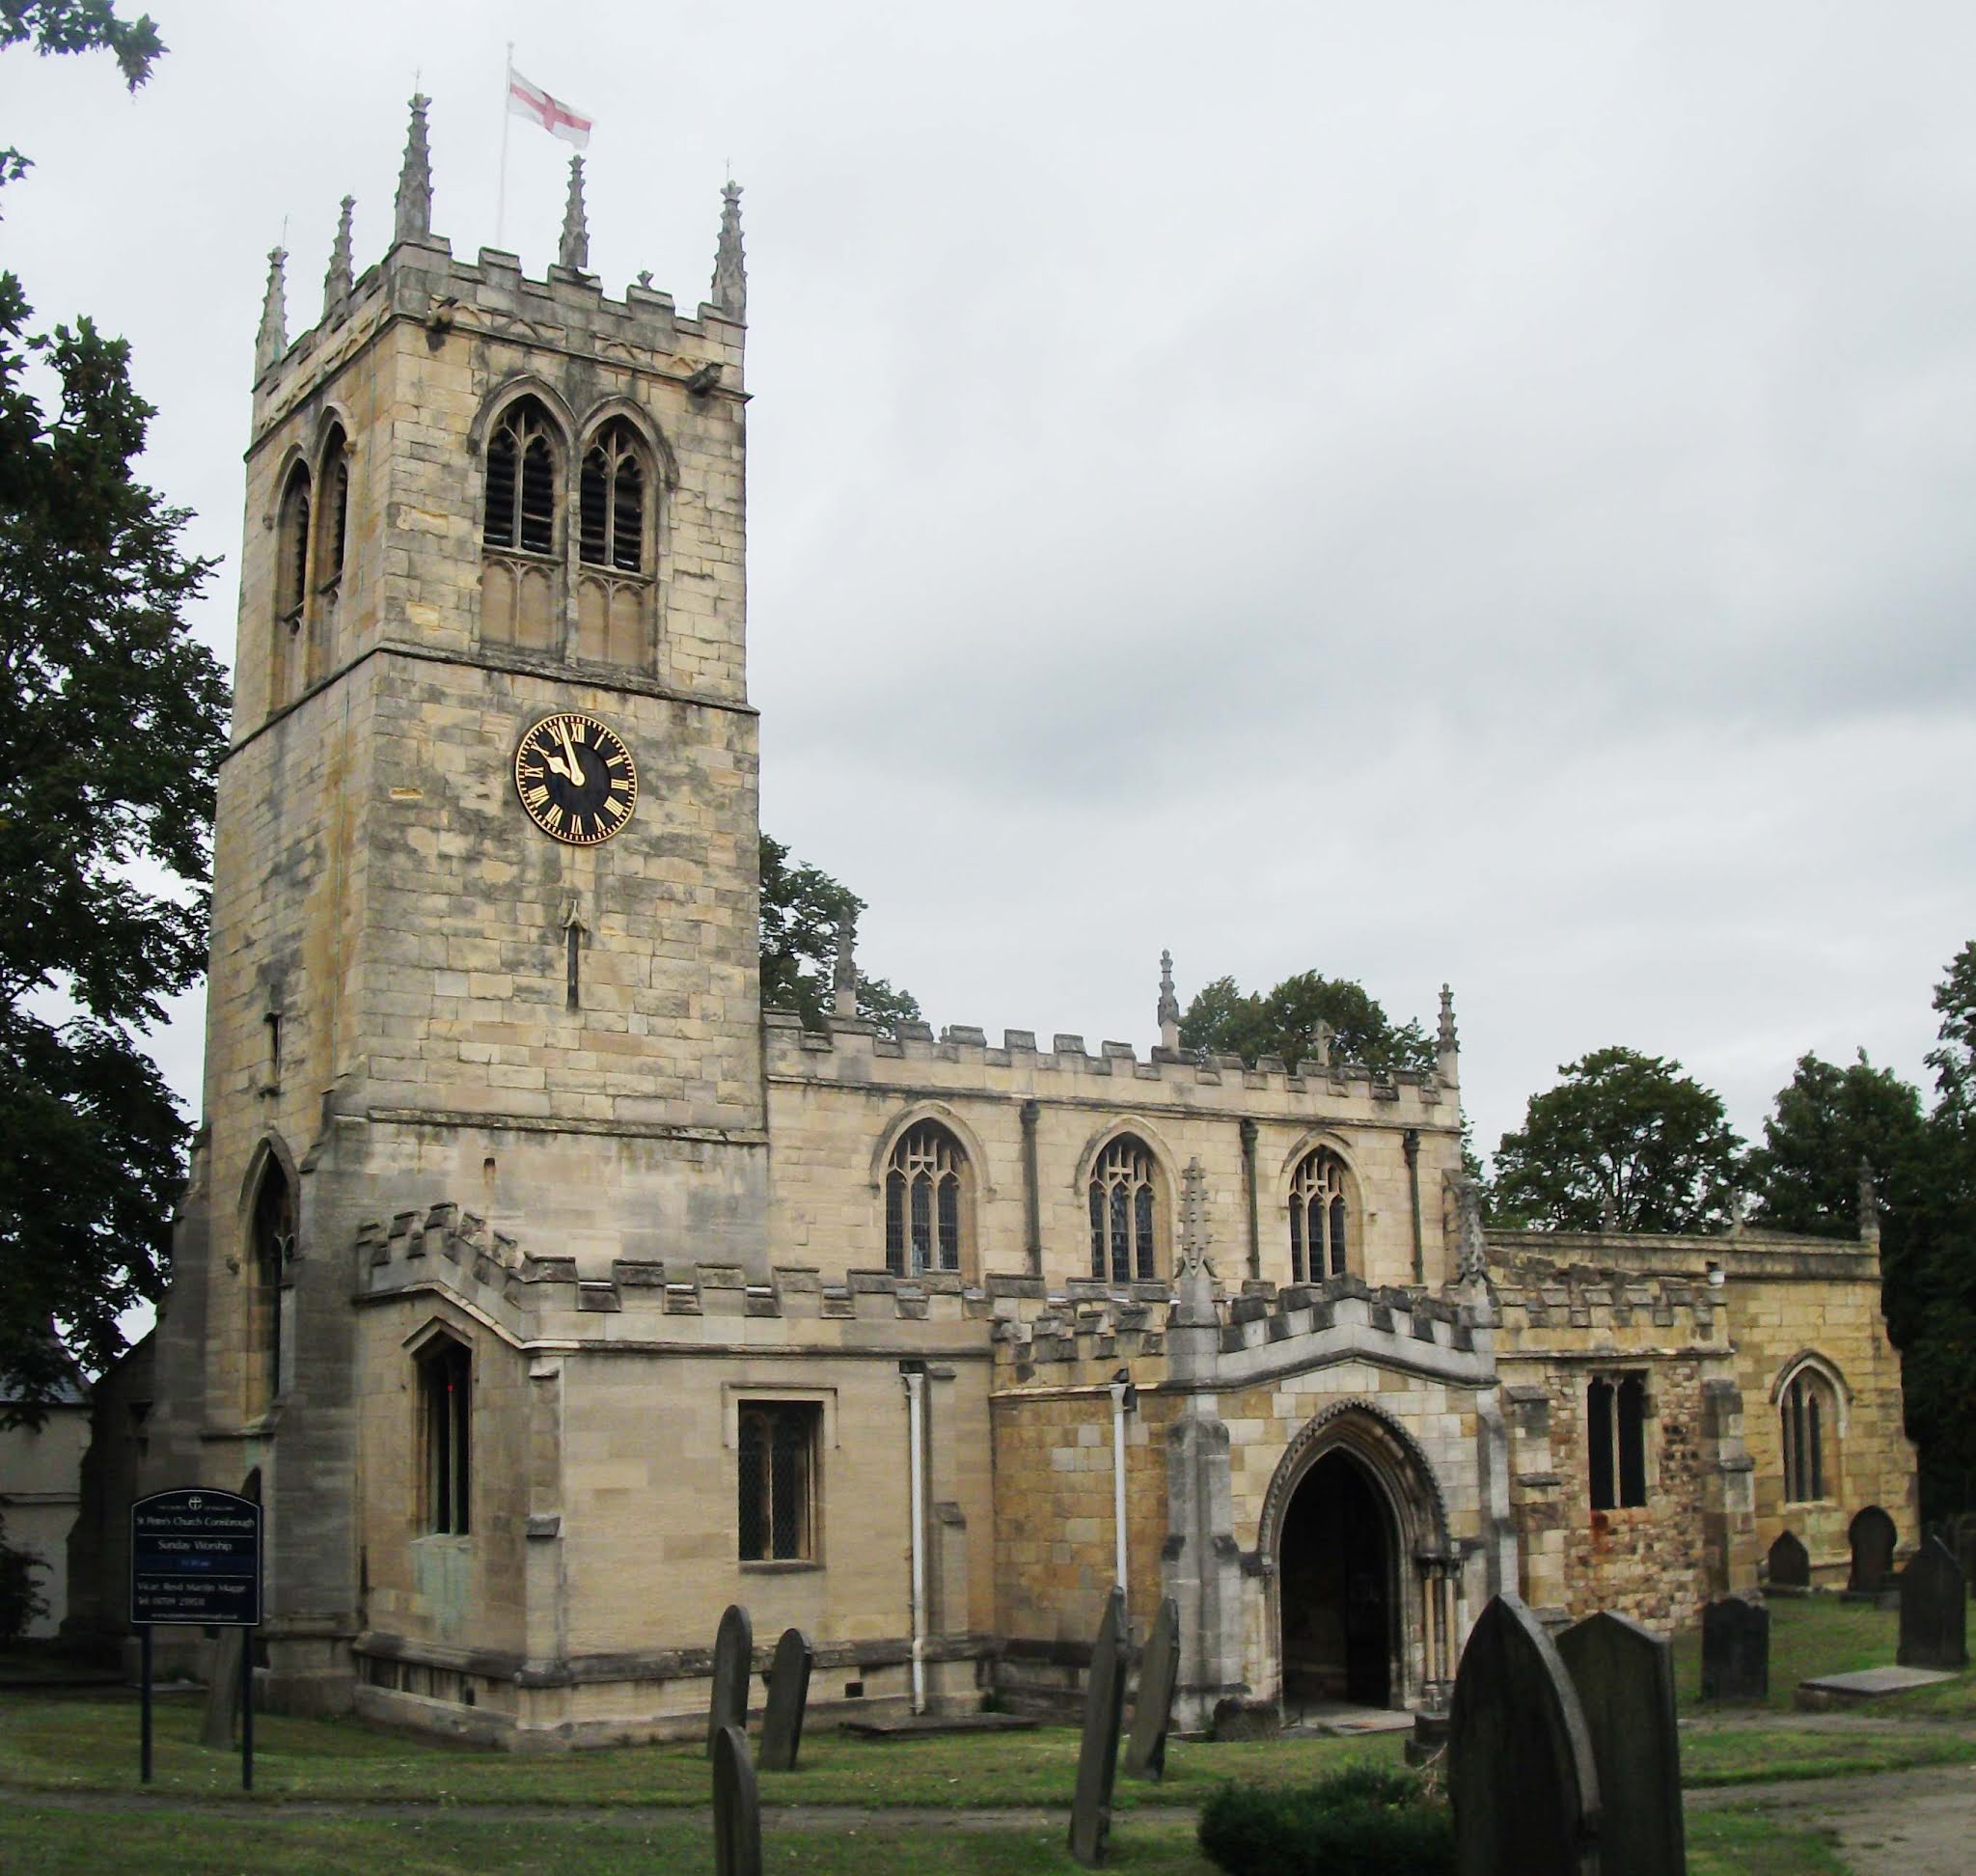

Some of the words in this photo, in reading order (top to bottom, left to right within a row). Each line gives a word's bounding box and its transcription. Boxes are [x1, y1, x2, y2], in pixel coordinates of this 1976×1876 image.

[570, 723, 586, 743] XII
[593, 733, 605, 750] I
[530, 741, 550, 758] X
[605, 755, 623, 768] II
[524, 764, 544, 779] IX
[611, 779, 629, 791] III
[528, 785, 550, 808] VIII
[603, 795, 624, 816] IIII
[545, 803, 563, 827] VII
[593, 812, 606, 832] V
[570, 814, 583, 835] VI
[173, 1517, 203, 1527] Church
[157, 1539, 190, 1551] Sunday
[194, 1540, 233, 1552] Worship
